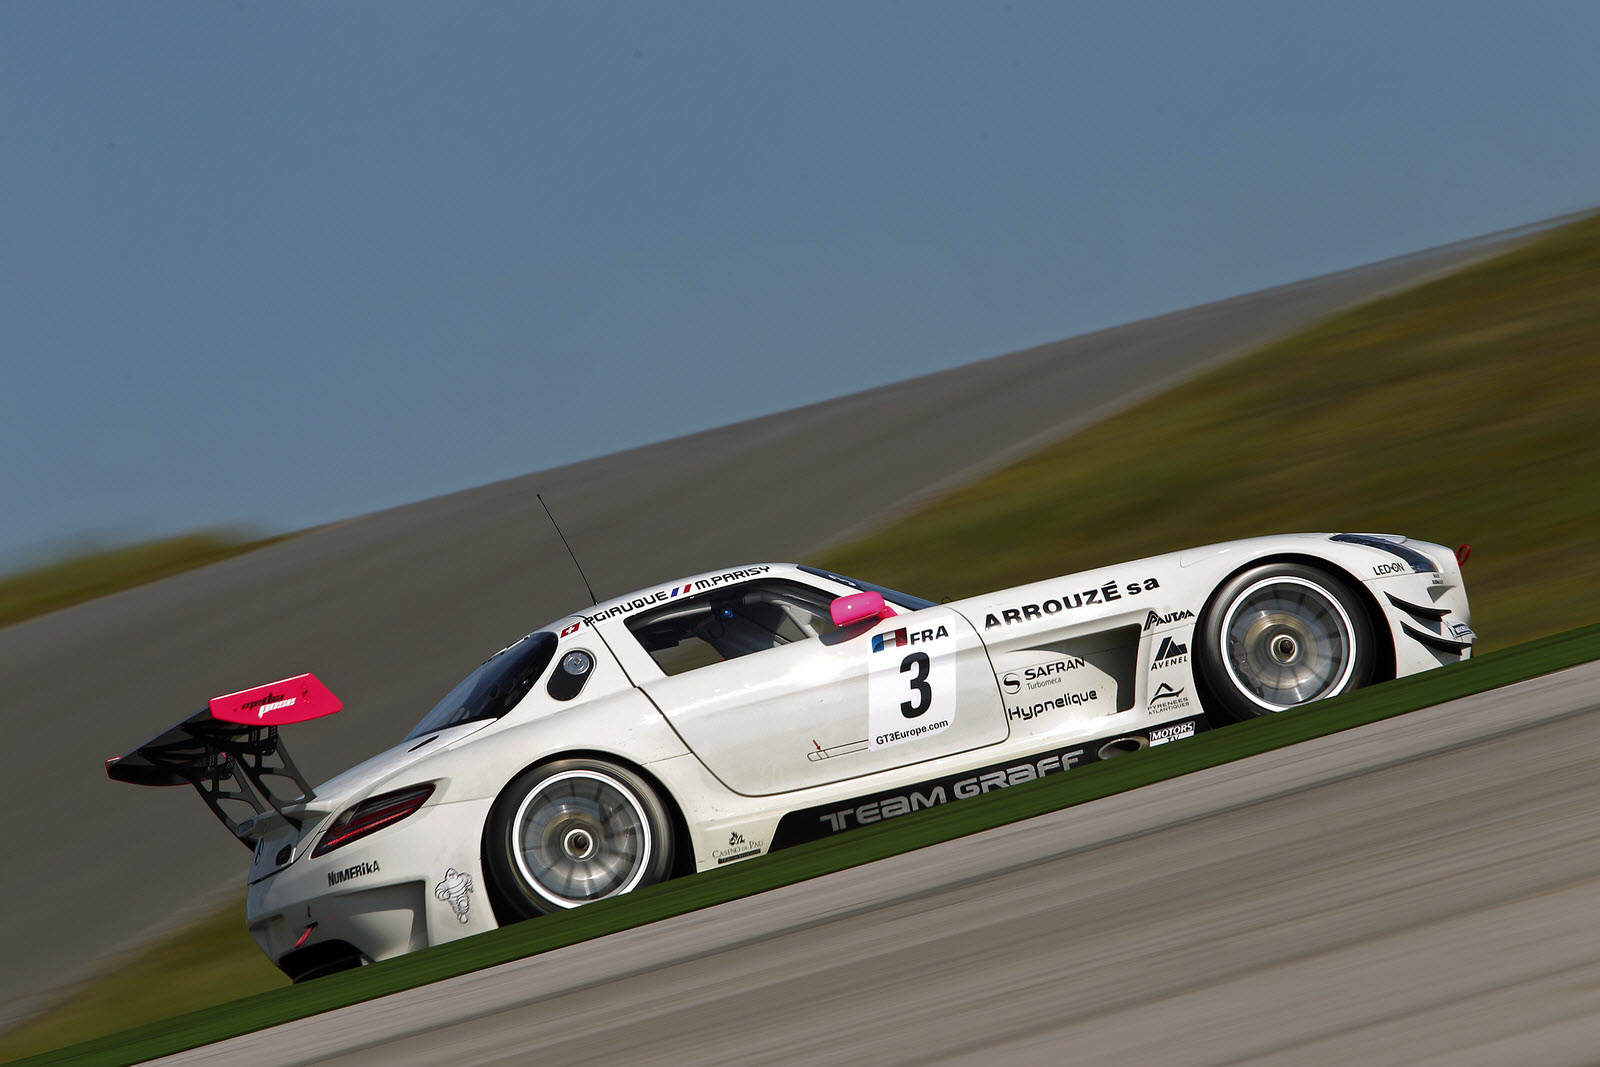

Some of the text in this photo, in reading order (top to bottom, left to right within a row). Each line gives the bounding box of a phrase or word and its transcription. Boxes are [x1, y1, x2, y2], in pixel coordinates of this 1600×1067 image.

[695, 565, 770, 590] M.PARISY
[583, 591, 669, 627] P.GIAUQUE
[985, 577, 1160, 631] ARROUZÉ sa
[910, 625, 949, 645] FRA
[1024, 657, 1085, 681] SAFRAN
[1150, 655, 1188, 672] AVENEL
[900, 652, 932, 719] 3
[1026, 676, 1062, 691] Turbomeca
[1008, 688, 1098, 722] Hypnelique
[1148, 702, 1190, 715] ATLANTIQUES
[875, 719, 949, 745] GT3Europe.com
[1151, 722, 1193, 741] MOTORS
[820, 749, 1084, 832] TEAM GRAFF
